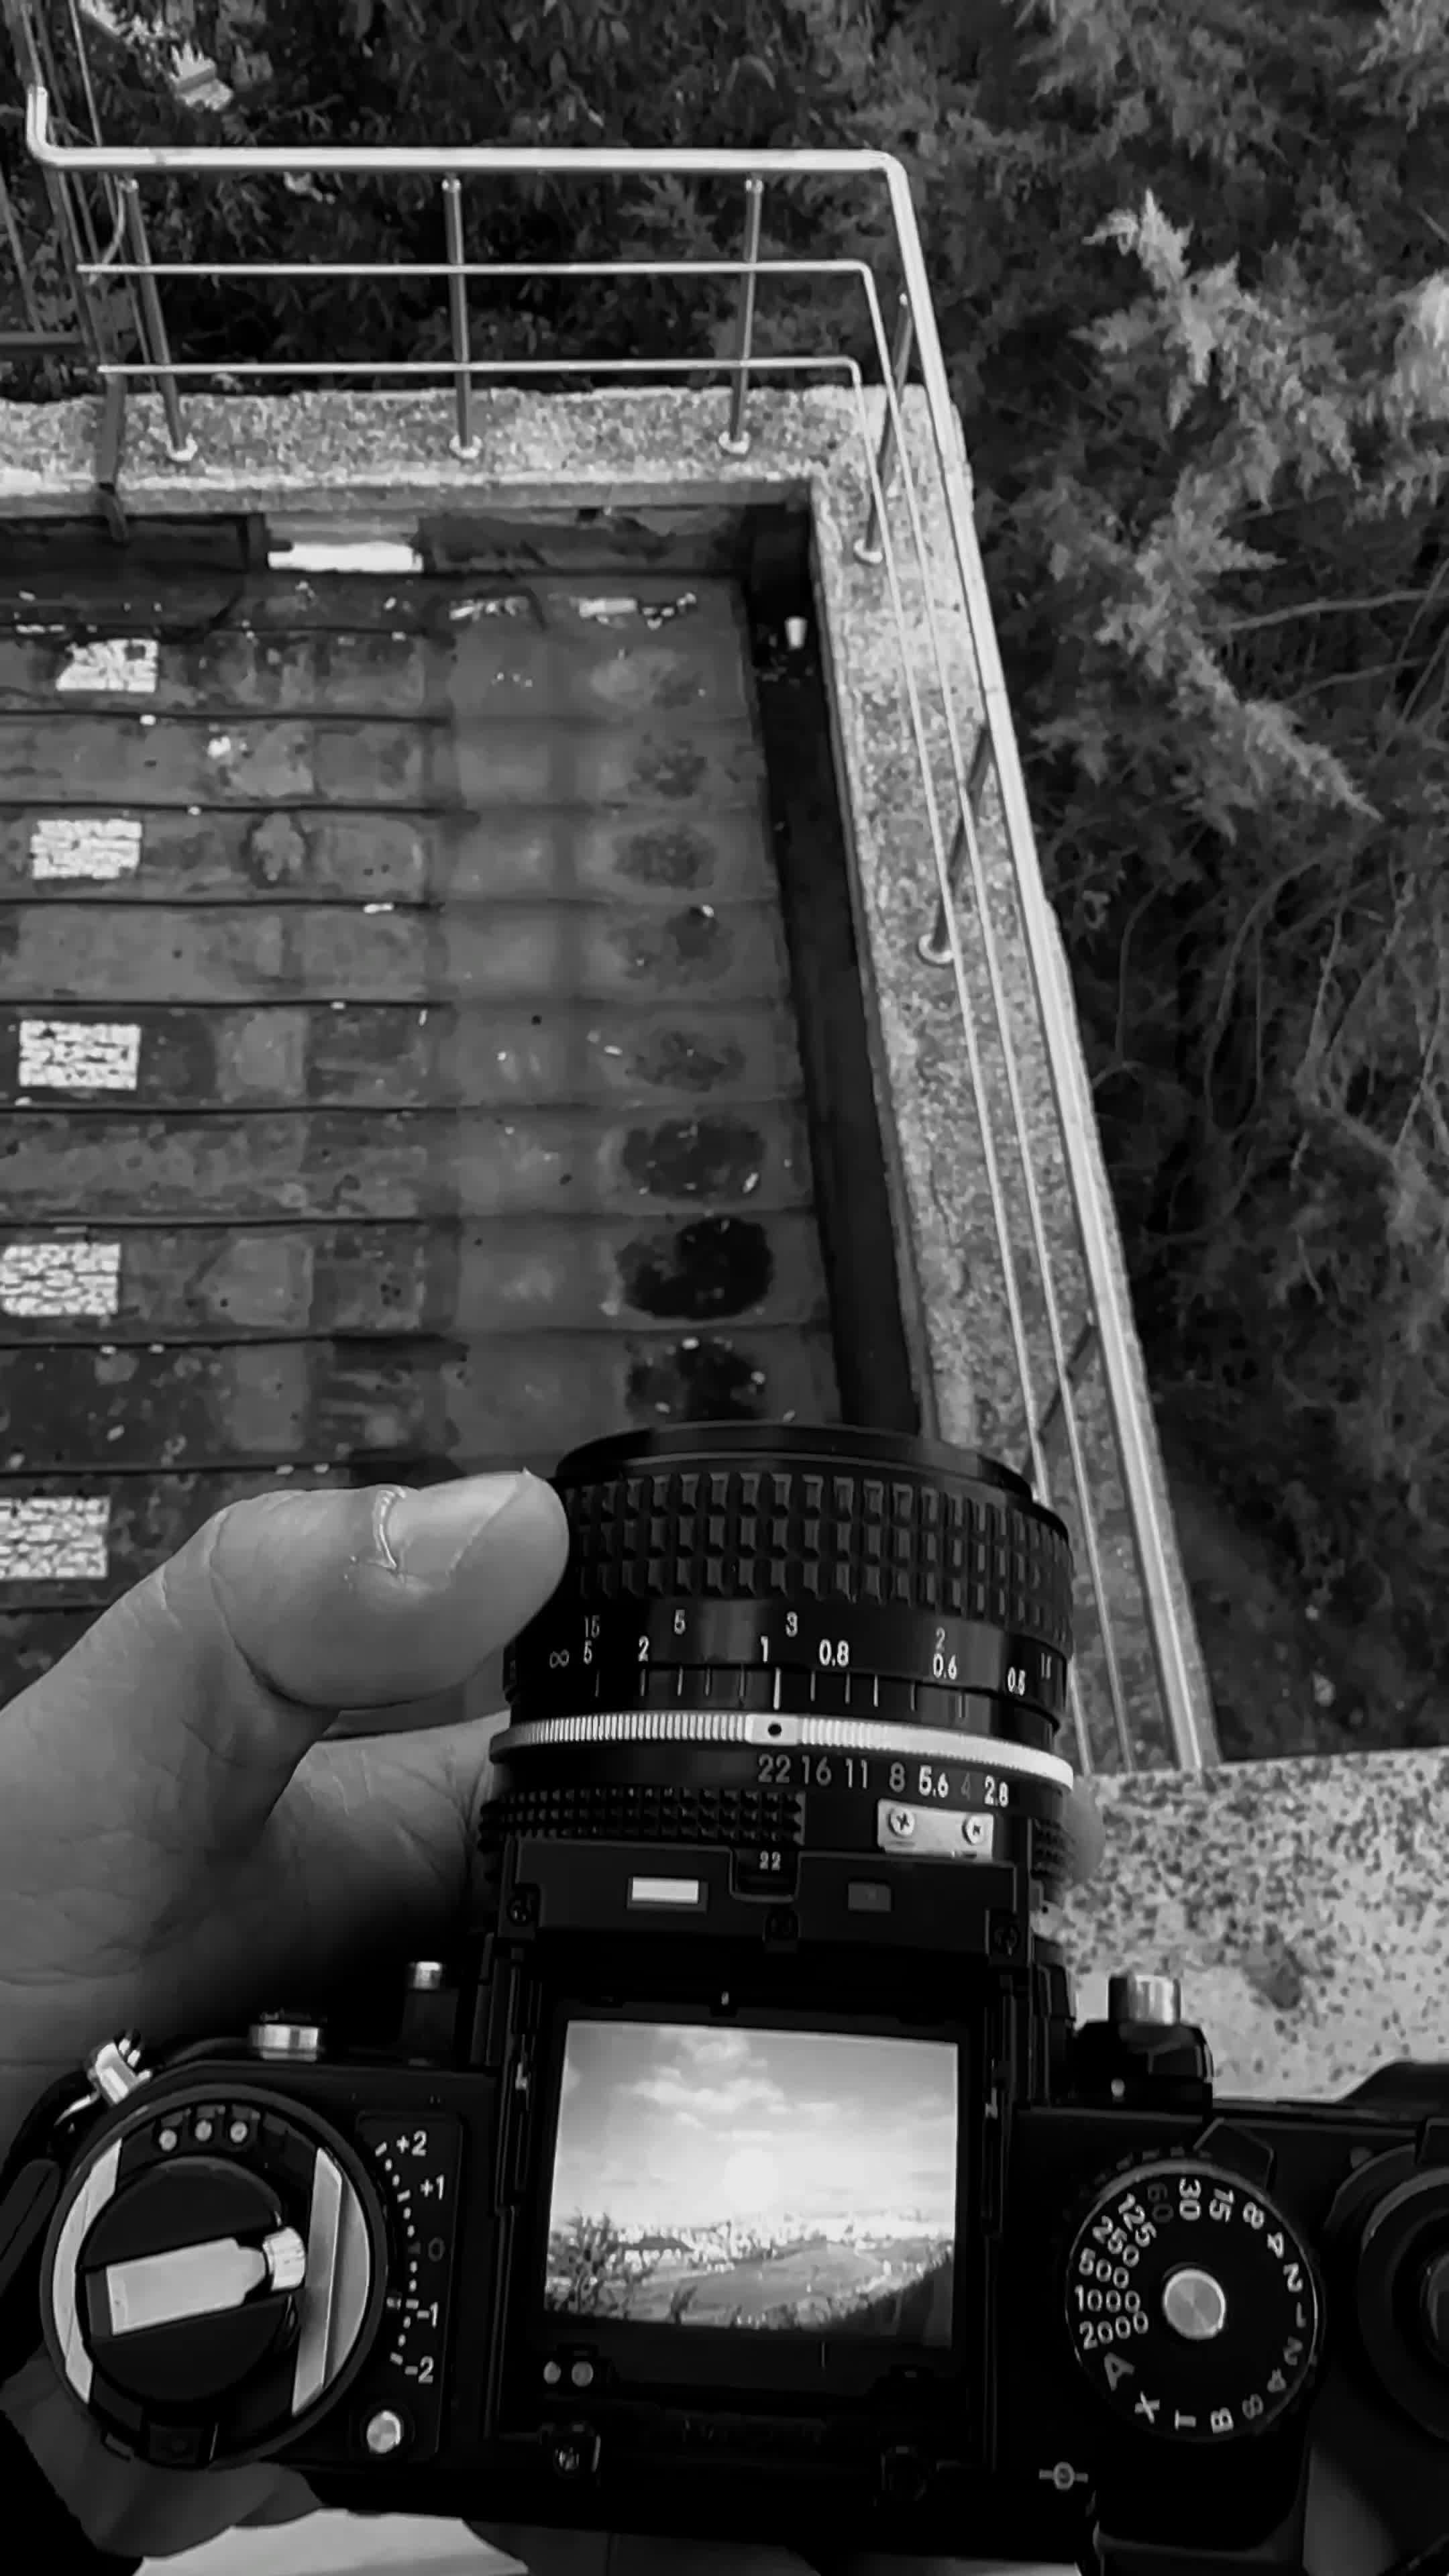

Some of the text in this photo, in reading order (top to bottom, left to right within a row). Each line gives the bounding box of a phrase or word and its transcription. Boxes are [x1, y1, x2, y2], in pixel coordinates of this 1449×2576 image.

[786, 1611, 798, 1637] 3
[935, 1627, 946, 1652] 2
[638, 1635, 650, 1662] 2
[759, 1635, 769, 1663] 1
[818, 1639, 850, 1668] 0.8
[932, 1653, 958, 1680] 0.6
[758, 1753, 1010, 1808] 22 16 11 8 5.6 4 2.8
[759, 1849, 782, 1871] 22
[396, 2130, 427, 2157] +2
[421, 2174, 445, 2200] +1
[1146, 2182, 1175, 2224] 60
[1179, 2178, 1201, 2221] 30
[1118, 2192, 1158, 2247] 125
[1209, 2188, 1235, 2222] 15
[1242, 2201, 1265, 2230] 8
[1092, 2214, 1140, 2267] 250
[1267, 2231, 1285, 2259] 4
[1078, 2247, 1130, 2290] 500
[1283, 2262, 1303, 2292] 2
[1074, 2284, 1141, 2313] 1000
[1078, 2310, 1149, 2350] 2000
[1104, 2352, 1135, 2391] A
[1134, 2390, 1161, 2424] X
[1174, 2408, 1197, 2431] T
[1210, 2407, 1234, 2434] B
